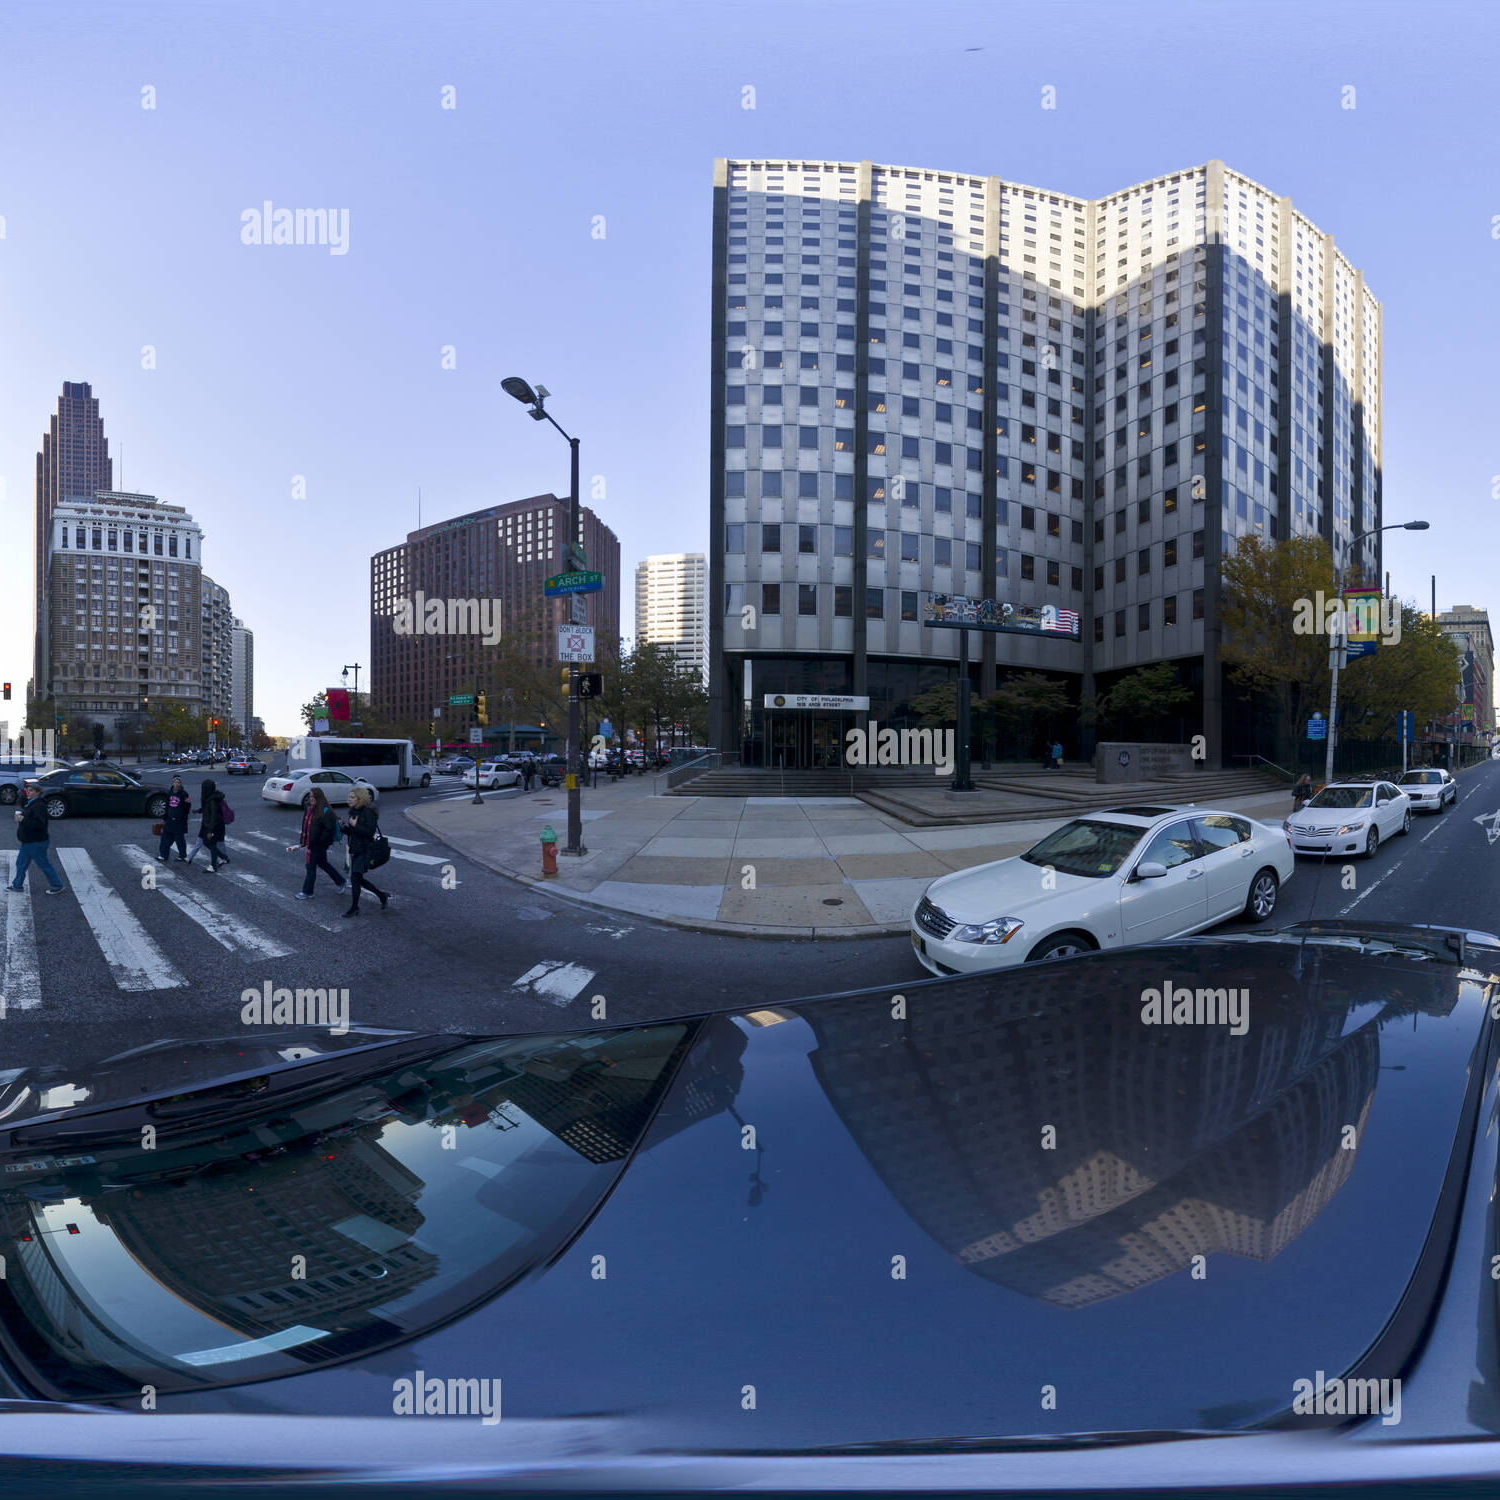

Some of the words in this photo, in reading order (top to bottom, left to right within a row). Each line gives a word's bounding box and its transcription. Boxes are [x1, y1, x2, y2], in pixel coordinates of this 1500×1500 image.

[557, 575, 586, 587] ARCH
[589, 574, 599, 582] ST
[560, 653, 574, 661] THE
[577, 653, 592, 661] BOX
